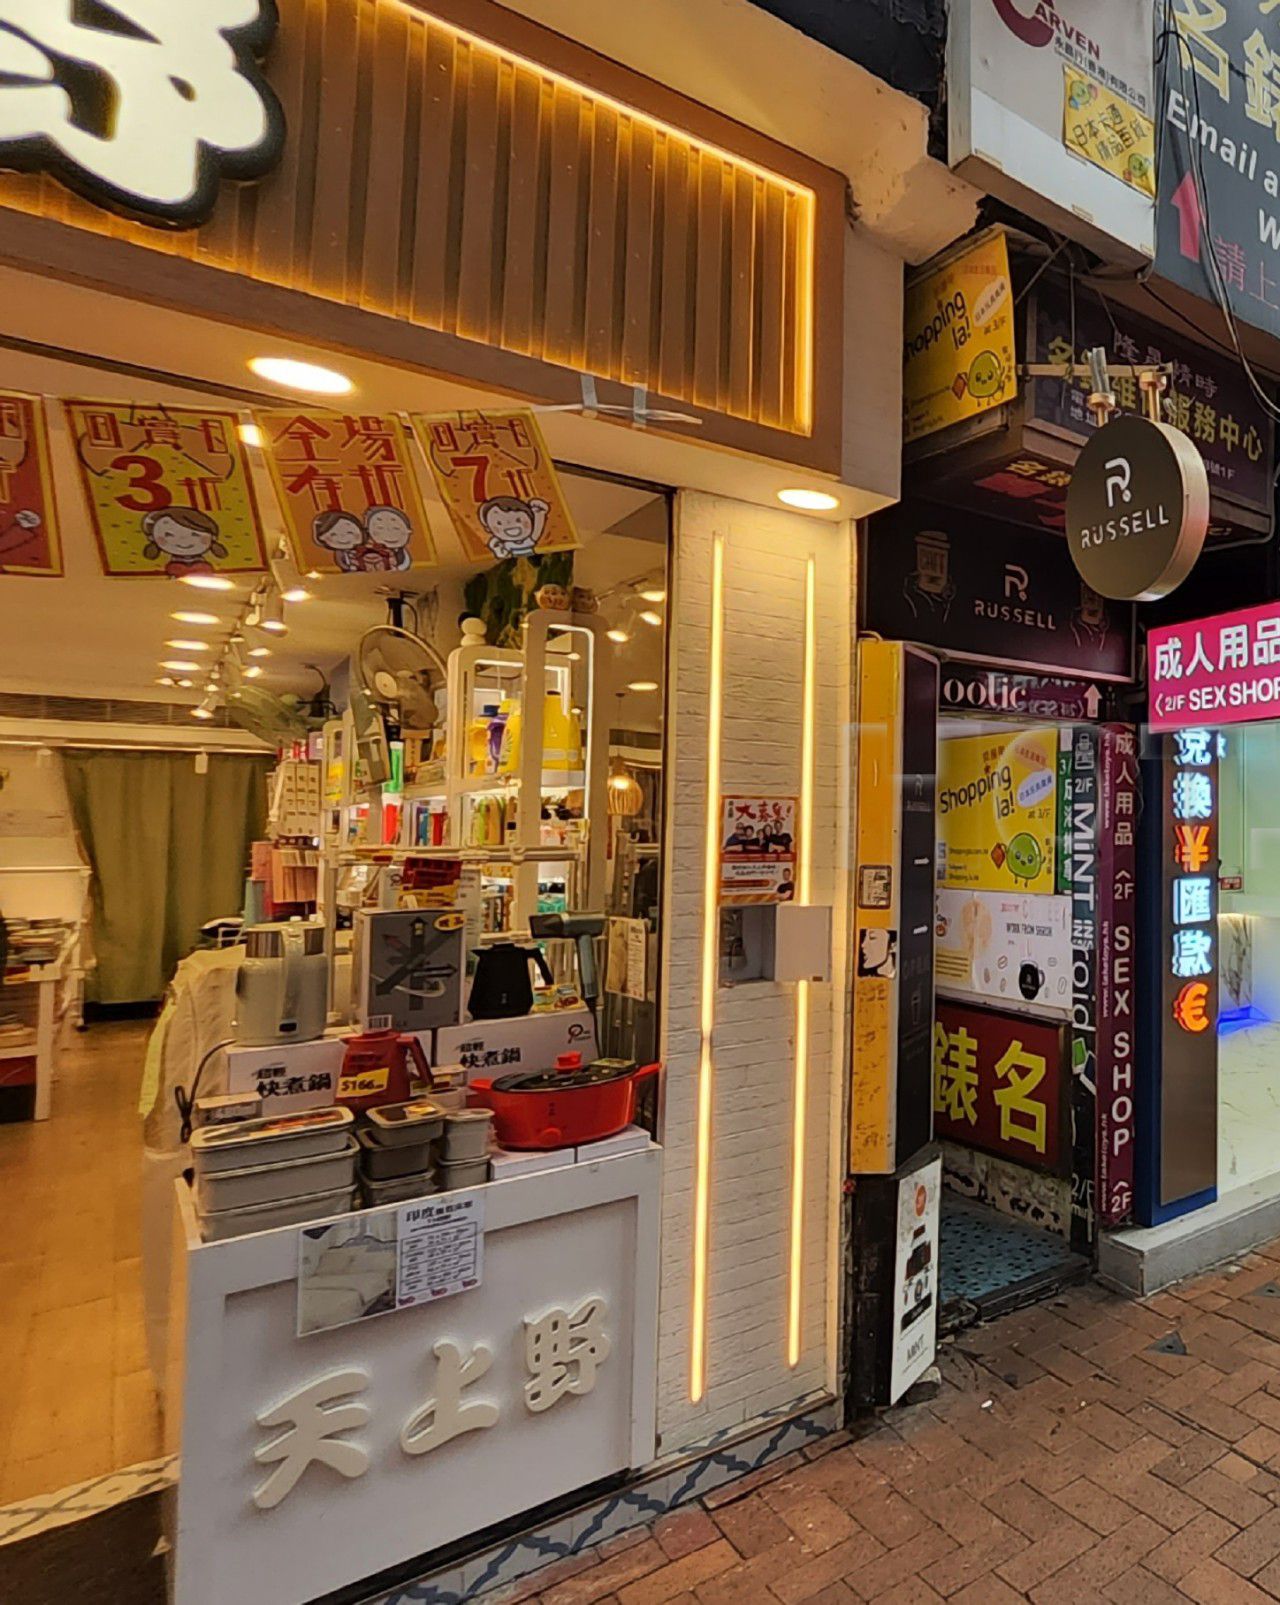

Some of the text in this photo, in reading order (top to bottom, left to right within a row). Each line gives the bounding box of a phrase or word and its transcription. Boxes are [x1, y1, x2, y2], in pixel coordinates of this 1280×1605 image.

[1167, 88, 1258, 182] Email
[951, 316, 972, 350] la!
[271, 414, 397, 463] 全場
[1080, 503, 1170, 549] RUSSELL
[974, 599, 1057, 631] RUSSELL
[1164, 693, 1187, 712] 2/F
[1188, 685, 1227, 711] SEX
[939, 765, 1012, 815] Shopping
[996, 790, 1016, 819] la!
[1074, 777, 1094, 794] 2/F
[1114, 732, 1134, 846] 成人用品
[1113, 883, 1134, 900] 2F
[1111, 924, 1133, 1157] SEX SHOP
[1111, 1190, 1132, 1213] 2F
[252, 1294, 611, 1512] 天上野
